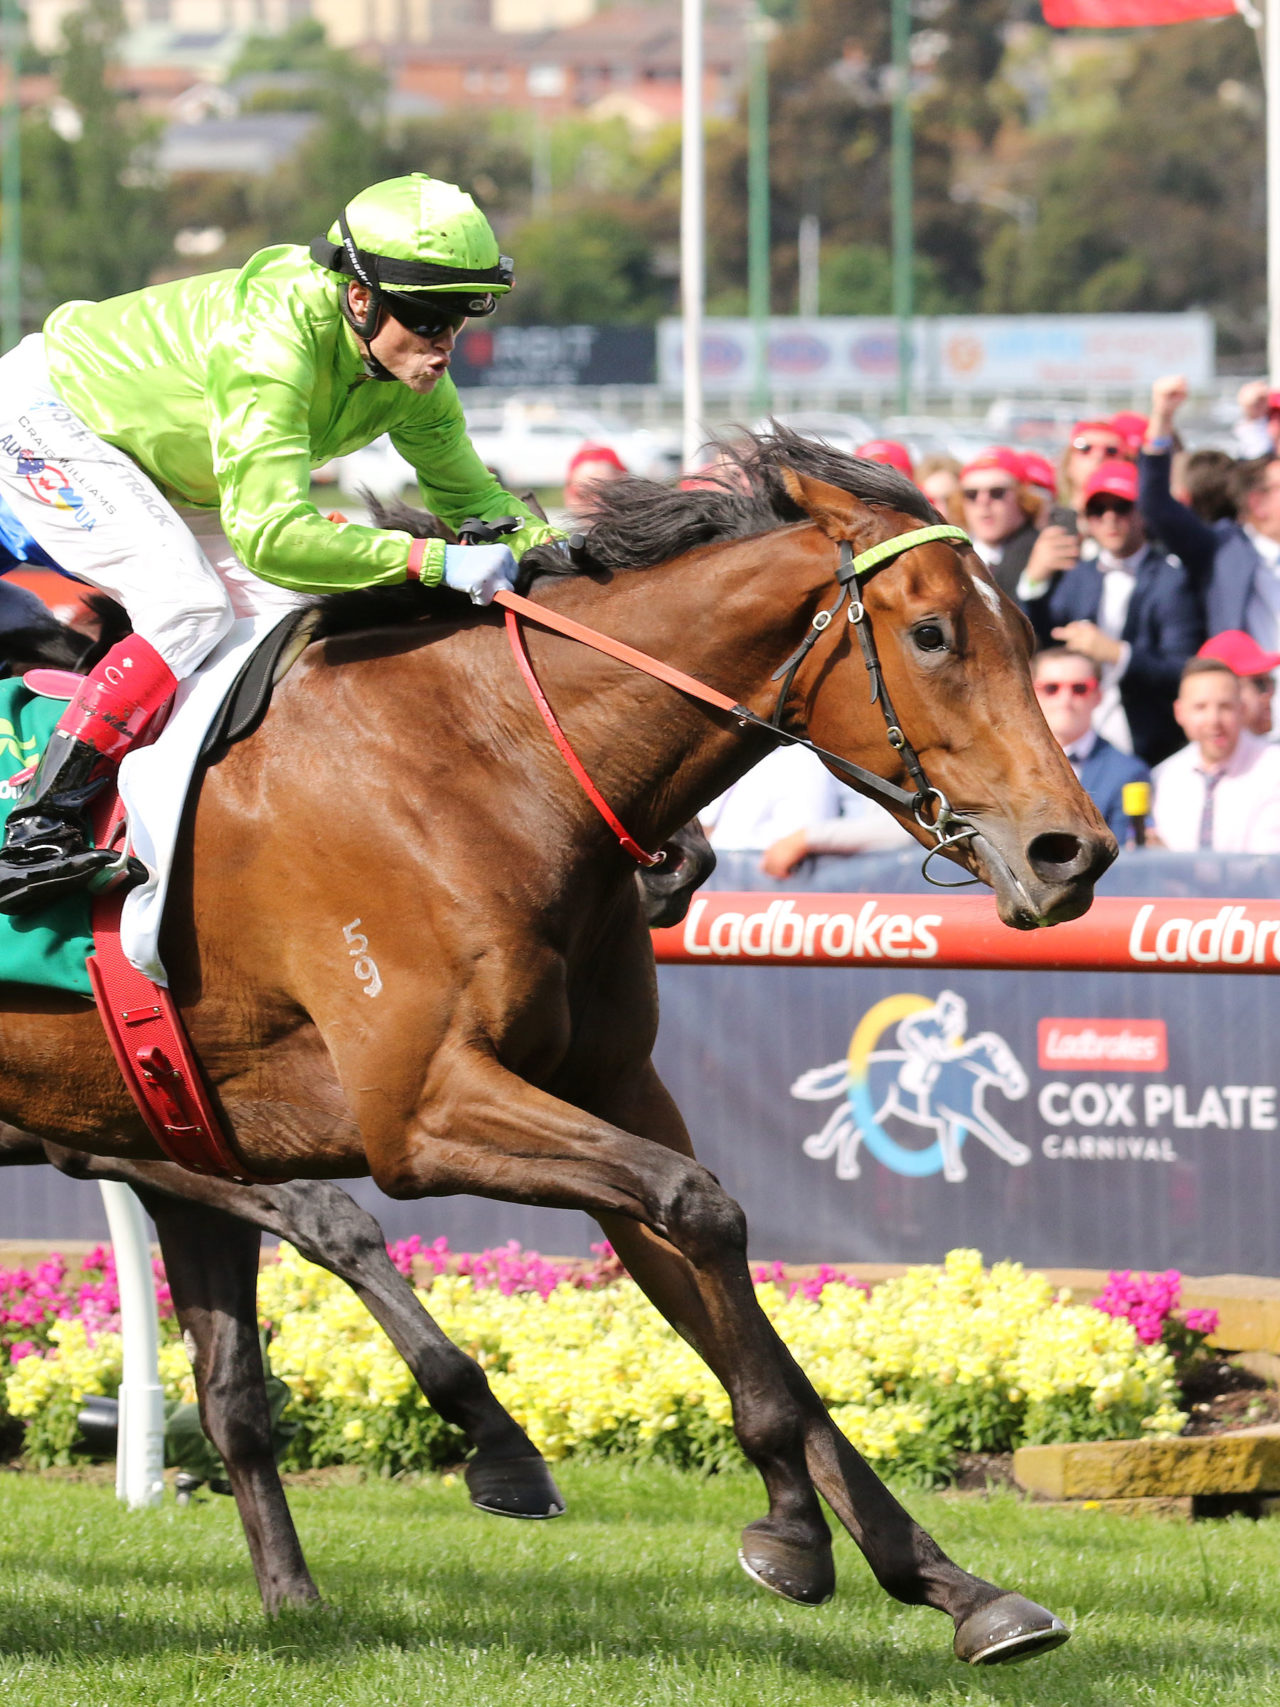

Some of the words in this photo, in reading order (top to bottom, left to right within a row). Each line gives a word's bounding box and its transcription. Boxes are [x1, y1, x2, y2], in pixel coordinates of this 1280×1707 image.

[18, 415, 56, 459] CRAIG
[58, 458, 117, 515] WILLIAMS
[74, 506, 97, 533] UA
[120, 471, 175, 528] TRACK
[683, 898, 943, 959] Ladbrokes
[1128, 904, 1280, 964] Ladbr
[1045, 1027, 1159, 1061] Ladbrokes
[1037, 1081, 1137, 1127] COX
[1144, 1084, 1278, 1130] PLATE
[1041, 1133, 1178, 1163] CARNIVAL
